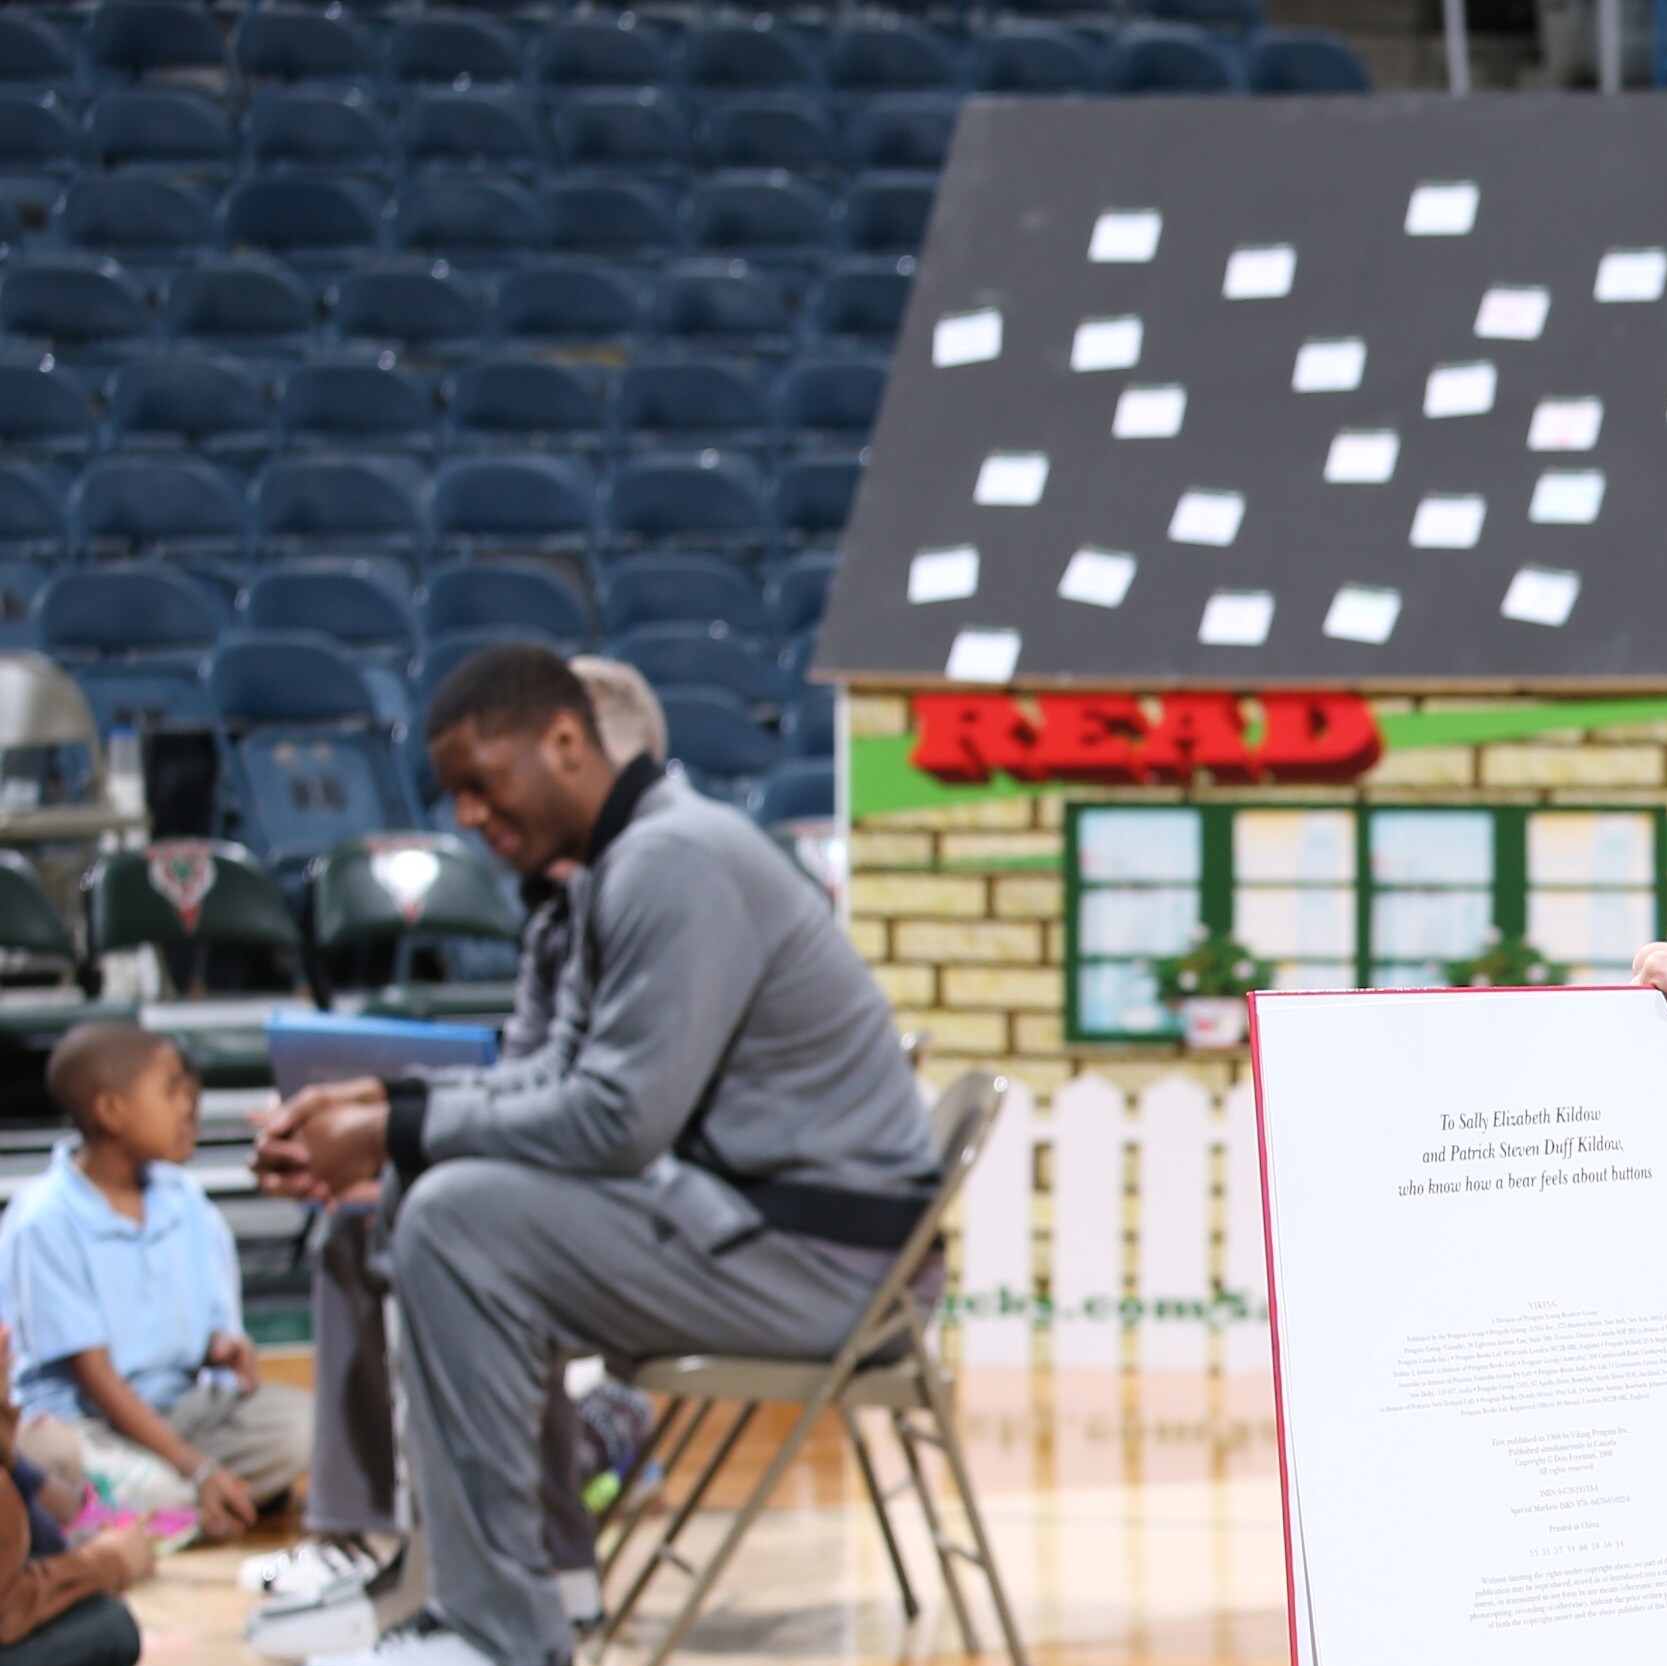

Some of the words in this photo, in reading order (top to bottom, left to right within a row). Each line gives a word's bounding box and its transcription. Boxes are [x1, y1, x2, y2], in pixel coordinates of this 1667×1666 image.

[912, 690, 1386, 786] READ
[1439, 1114, 1455, 1130] To
[1458, 1112, 1488, 1133] Sally
[1493, 1108, 1550, 1127] Elizabeth
[1556, 1105, 1601, 1123] Kildow
[1422, 1146, 1446, 1163] and
[1450, 1143, 1495, 1161] Patrick
[1499, 1142, 1540, 1158] Steven
[1544, 1138, 1575, 1160] Duff
[1578, 1136, 1624, 1153] Kildow,
[1398, 1180, 1424, 1197] who
[1428, 1178, 1461, 1194] know
[1465, 1176, 1491, 1192] how
[1495, 1179, 1503, 1190] a
[1508, 1173, 1536, 1189] bear
[1539, 1170, 1568, 1192] feels
[1572, 1168, 1607, 1185] about
[1611, 1166, 1652, 1182] buttons
